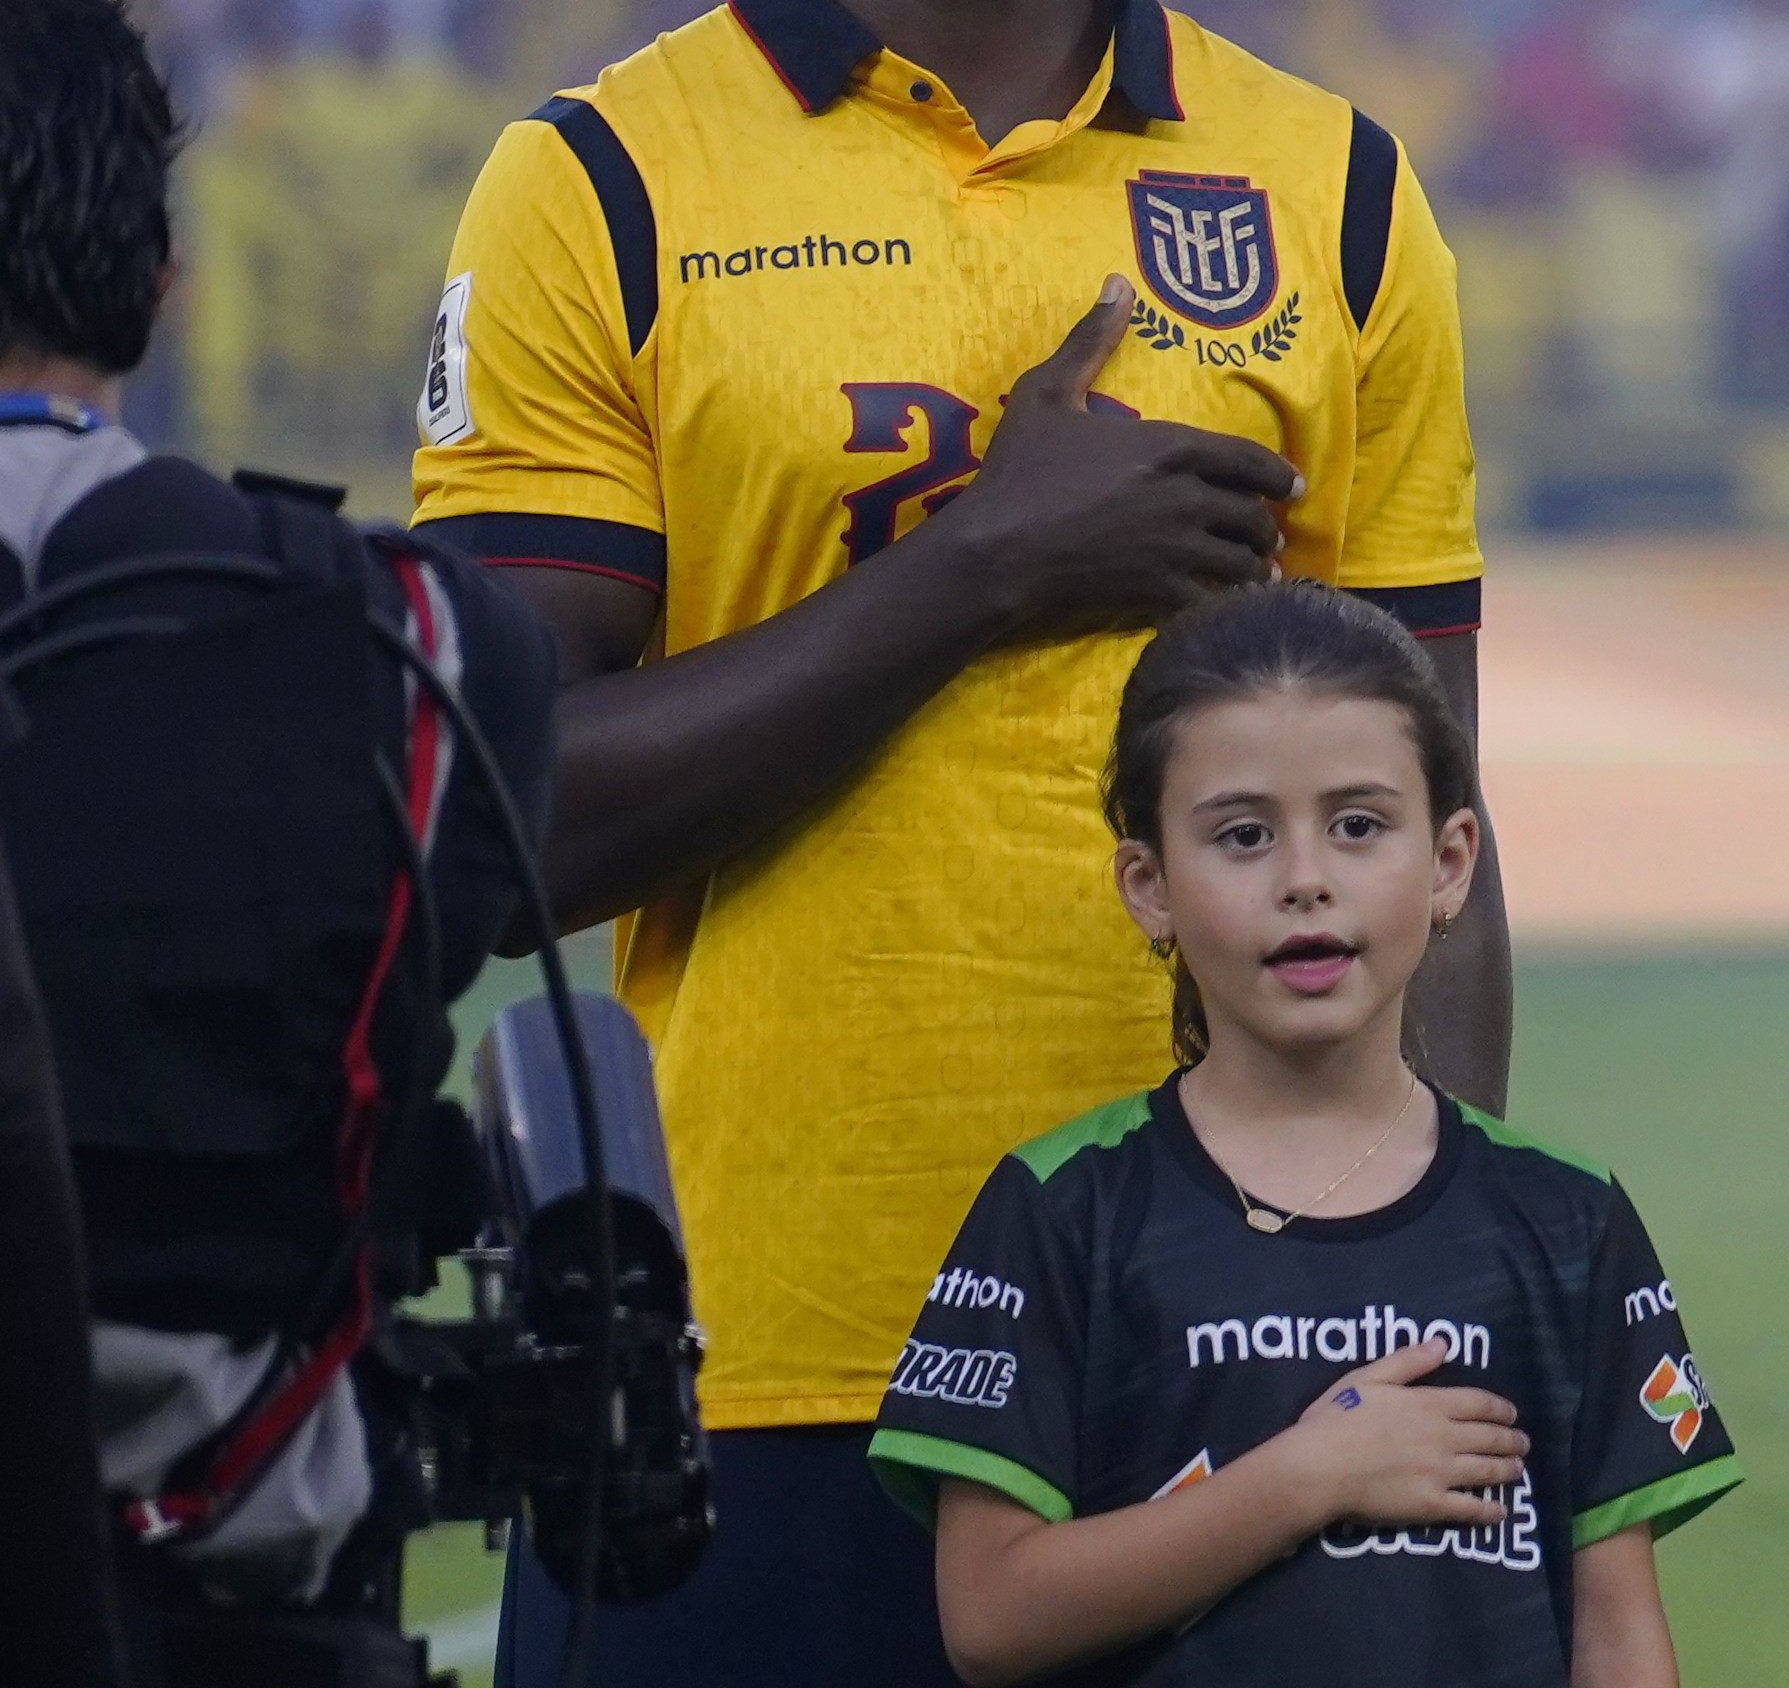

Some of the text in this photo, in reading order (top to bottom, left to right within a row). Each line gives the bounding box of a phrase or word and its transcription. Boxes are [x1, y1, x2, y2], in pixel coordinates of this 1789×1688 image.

[680, 232, 912, 283] marathon
[1194, 337, 1247, 368] 100
[1186, 1304, 1492, 1370] marathon
